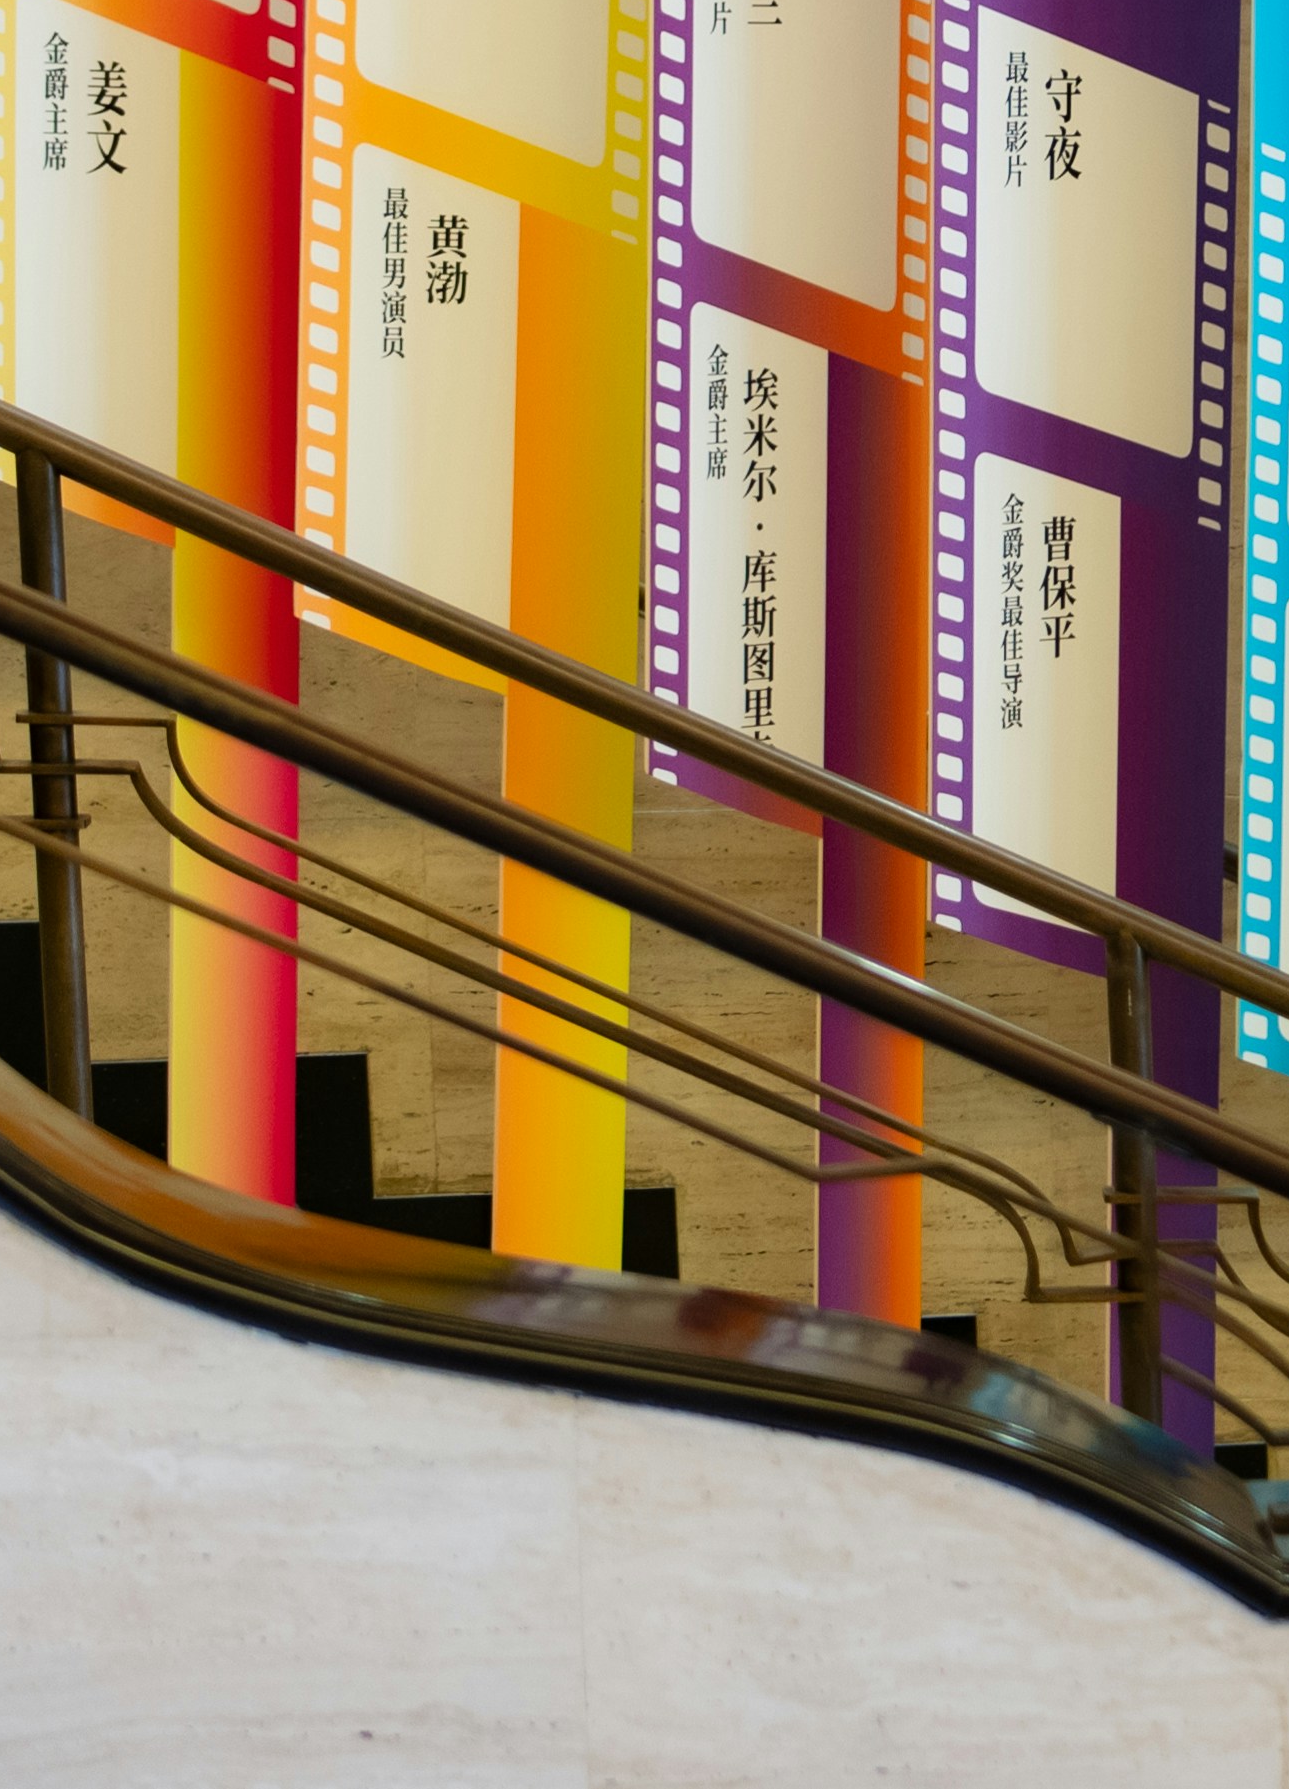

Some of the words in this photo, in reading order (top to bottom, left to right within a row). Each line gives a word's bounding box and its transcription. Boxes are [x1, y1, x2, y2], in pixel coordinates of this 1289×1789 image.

[42, 31, 69, 171] 金爵主席
[86, 60, 127, 176] 姜文
[1004, 51, 1029, 188] 最佳影片
[1044, 69, 1083, 181] 守夜
[381, 187, 409, 359] 最佳男演员
[425, 213, 469, 305] 黄渤
[706, 343, 729, 481] 金爵主席
[741, 367, 778, 749] 埃米尔·库斯图里
[1000, 492, 1025, 731] 金爵奖最佳导演
[1038, 516, 1077, 660] 曹保平
